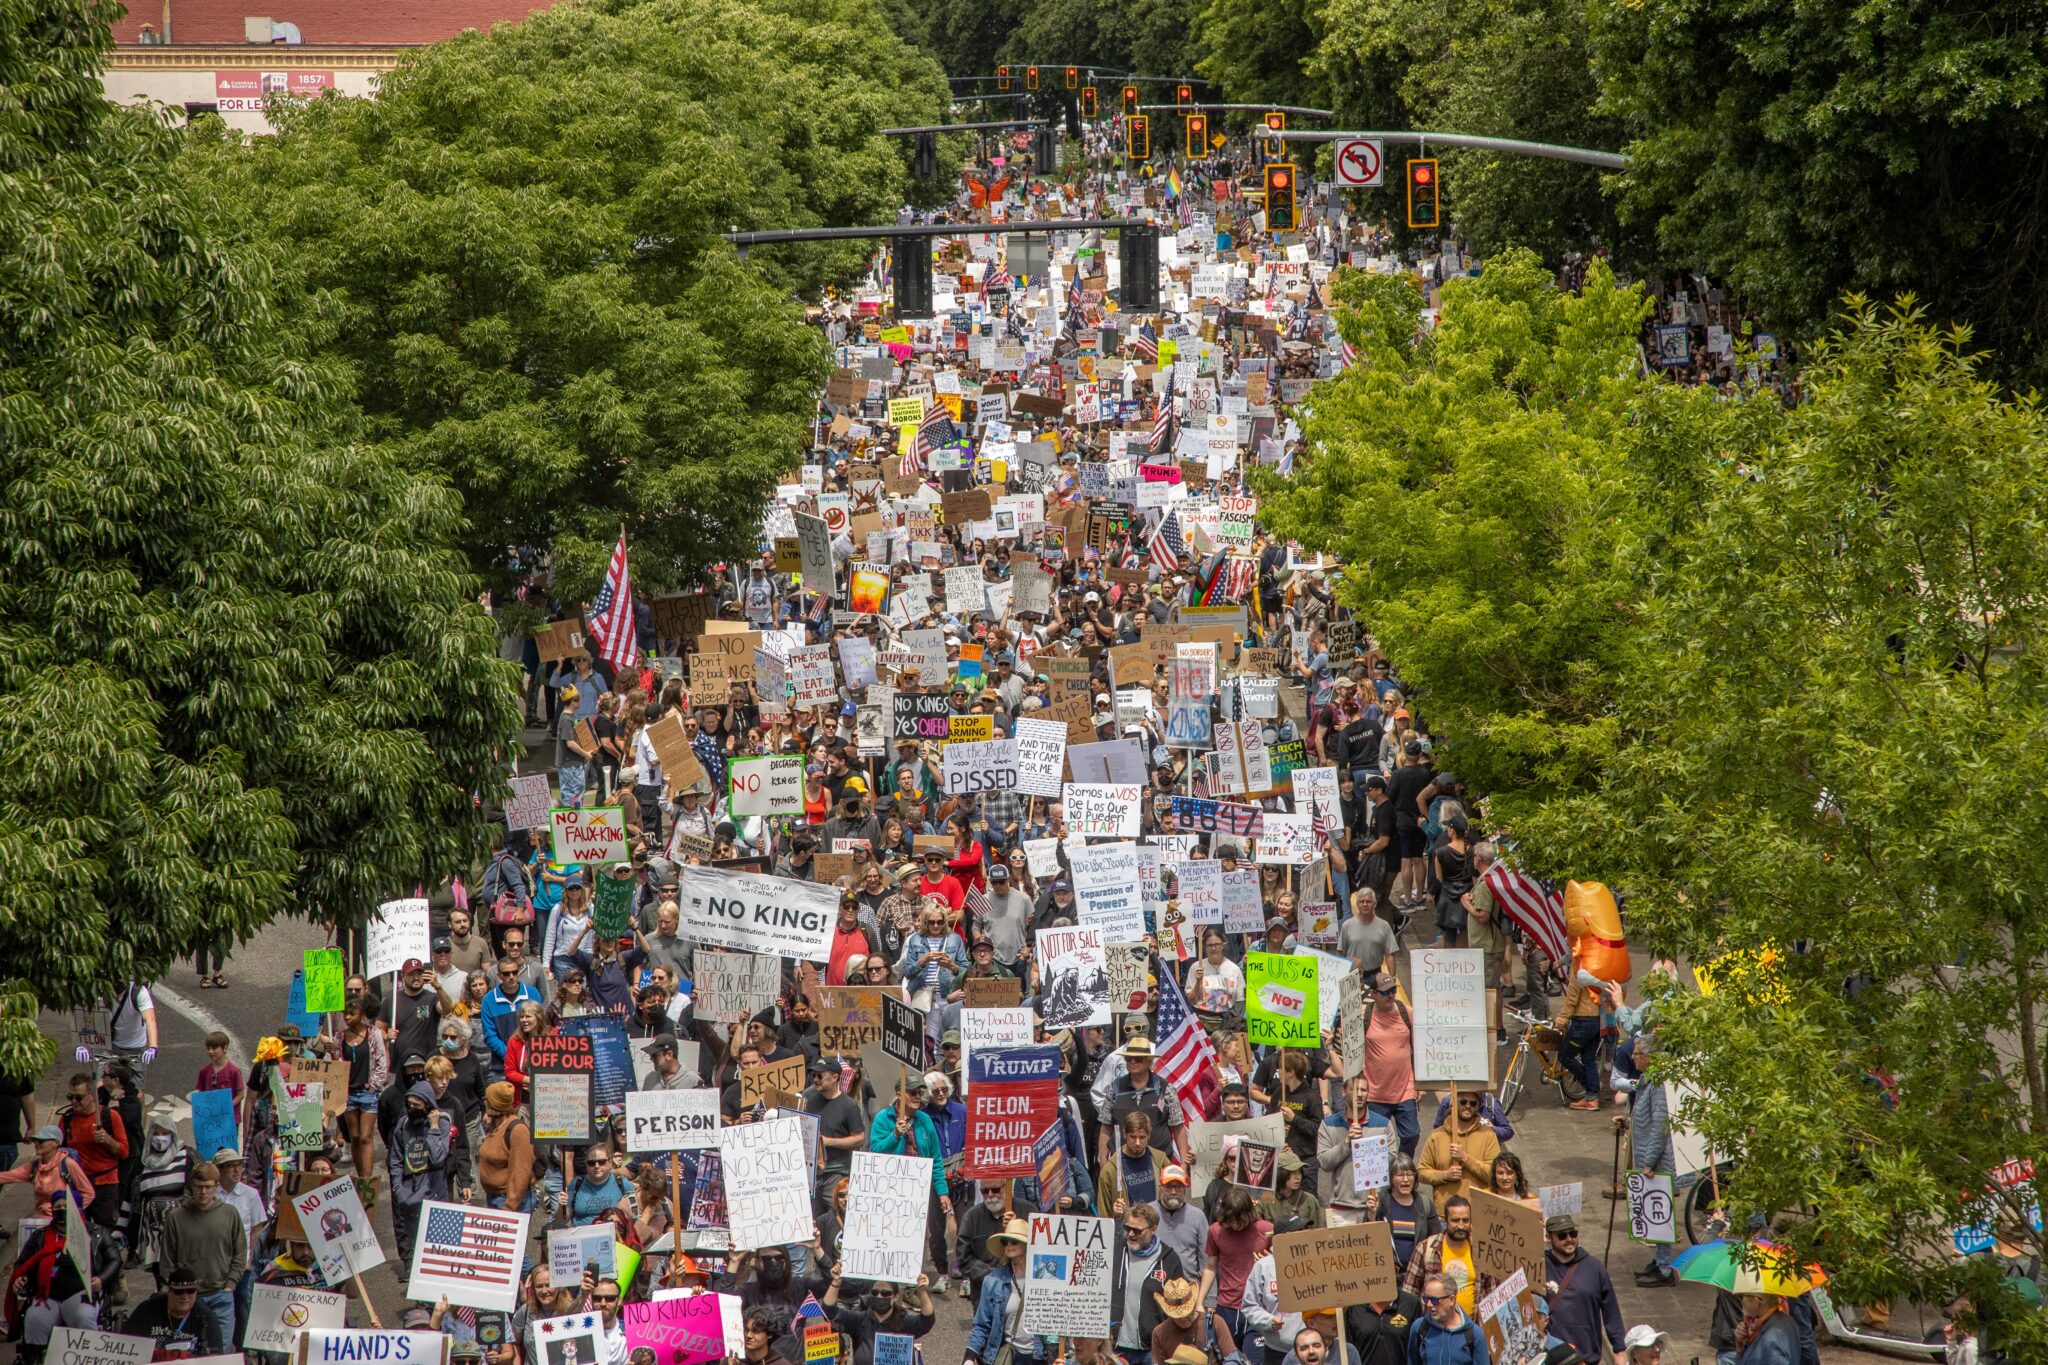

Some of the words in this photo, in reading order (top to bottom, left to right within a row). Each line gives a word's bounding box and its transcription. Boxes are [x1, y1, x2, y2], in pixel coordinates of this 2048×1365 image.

[299, 75, 325, 84] 1857!
[219, 99, 244, 110] FOR
[908, 386, 931, 395] LOVE
[981, 399, 1001, 407] WORST
[982, 413, 1004, 422] BETTER
[1209, 440, 1234, 448] RESIST
[1144, 467, 1177, 478] TRUMP
[1182, 464, 1206, 474] FIGHT
[1021, 501, 1035, 509] THE
[1223, 497, 1252, 511] STOP
[909, 511, 930, 519] FUCK
[1219, 511, 1254, 522] FASCISM
[798, 517, 826, 532] LOCK
[1222, 522, 1251, 534] SAVE
[909, 528, 931, 537] FUCK
[800, 533, 828, 549] THEM
[1217, 535, 1252, 547] DEMOCRACY
[809, 554, 826, 568] UP
[852, 562, 890, 574] TRAITOR
[655, 599, 708, 619] FIGHT
[719, 638, 744, 655] NO
[692, 656, 721, 668] Don't
[792, 654, 808, 663] THE
[810, 652, 828, 660] POOR
[879, 653, 925, 664] IMPEACH
[803, 662, 818, 670] WILL
[692, 672, 703, 682] go
[707, 668, 725, 679] back
[701, 681, 714, 691] to
[805, 678, 823, 689] EAT
[695, 690, 726, 705] sleep!
[953, 718, 979, 727] STOP
[1169, 708, 1208, 739] KINGS
[949, 728, 986, 737] ARMING
[968, 743, 982, 757] the
[984, 740, 1012, 758] People
[1020, 739, 1038, 749] AND
[1040, 741, 1061, 752] THEN
[1278, 741, 1303, 753] RICH
[1018, 749, 1038, 761] THEY
[1039, 752, 1061, 764] CAME
[1283, 751, 1303, 761] OUT
[770, 759, 802, 770] DICTATORS
[972, 759, 990, 769] ARE
[1019, 761, 1036, 772] FOR
[1039, 763, 1053, 774] ME
[951, 768, 1017, 793] PISSED
[1294, 772, 1306, 781] NO
[1309, 770, 1333, 780] KINGS
[732, 773, 761, 794] NO
[772, 776, 798, 786] KINGS
[1068, 785, 1103, 798] Somos
[1115, 787, 1138, 801] VOS
[1068, 798, 1083, 810] De
[1108, 802, 1128, 814] Que
[556, 812, 578, 825] NO
[1070, 811, 1082, 819] NO
[1086, 811, 1124, 823] Pueden
[565, 826, 624, 844] FAUX-KING
[1068, 820, 1119, 836] GRITAR!
[574, 848, 608, 860] WAY
[1258, 846, 1289, 856] PEOPLE
[1180, 866, 1220, 876] AMENDMENT
[1080, 887, 1124, 899] Separation
[1125, 885, 1134, 893] of
[1143, 881, 1157, 889] NO
[741, 888, 777, 898] WATCHING!
[1089, 898, 1128, 911] Powers
[708, 896, 746, 920] NO
[754, 904, 827, 933] KING!
[1102, 912, 1138, 925] president
[687, 919, 706, 927] Stand
[730, 925, 767, 937] constitution.
[771, 931, 787, 940] June
[1106, 923, 1124, 932] obey
[1126, 922, 1139, 930] the
[1158, 931, 1173, 939] NO
[1040, 931, 1062, 966] NOT
[1062, 931, 1076, 950] FOR
[1078, 929, 1100, 949] SALE
[1248, 962, 1264, 972] THE
[1268, 956, 1299, 981] US
[1302, 968, 1314, 979] IS
[1271, 992, 1302, 1011] NOT
[967, 1012, 986, 1028] Hey
[963, 1027, 994, 1040] Nobody
[1018, 1031, 1029, 1040] us
[1251, 1018, 1278, 1039] FOR
[1281, 1021, 1317, 1039] SALE
[531, 1036, 589, 1052] HANDS
[885, 1030, 909, 1059] FELON
[909, 1046, 920, 1066] 47
[531, 1052, 558, 1067] OFF
[562, 1054, 594, 1070] OUR
[974, 1053, 1053, 1078] TRUMP
[744, 1065, 801, 1100] RESIST
[287, 1084, 306, 1098] WE
[976, 1096, 1034, 1116] FELON.
[634, 1114, 715, 1135] PERSON
[975, 1120, 1035, 1140] FRAUD.
[722, 1119, 801, 1150] AMERICA
[724, 1157, 750, 1178] NO
[756, 1150, 803, 1175] KING
[855, 1155, 880, 1173] THE
[885, 1156, 926, 1177] ONLY
[851, 1175, 928, 1198] MINORITY
[300, 1195, 321, 1216] NO
[323, 1180, 354, 1201] KINGS
[729, 1195, 766, 1221] RED
[769, 1189, 806, 1215] HAT
[847, 1194, 926, 1218] DESTROYING
[470, 1216, 508, 1234] Kings
[846, 1215, 924, 1238] AMERICA
[473, 1232, 498, 1247] Will
[732, 1224, 768, 1249] RED
[771, 1216, 809, 1243] COAT
[1031, 1217, 1107, 1249] MAFA
[1488, 1223, 1506, 1240] NO
[1510, 1232, 1525, 1248] TO
[554, 1243, 569, 1252] How
[874, 1240, 888, 1248] IS
[431, 1244, 472, 1259] Never
[475, 1249, 506, 1263] Rule
[555, 1251, 567, 1259] Win
[1075, 1250, 1104, 1260] MAKE
[555, 1259, 581, 1267] Election
[843, 1250, 922, 1279] BILLIONAIRES
[1073, 1259, 1109, 1270] AMERICA
[1284, 1260, 1316, 1280] OUR
[1322, 1253, 1371, 1274] PARADE
[1376, 1253, 1386, 1267] is
[1478, 1241, 1543, 1283] FASCISM!
[450, 1263, 480, 1277] U.S.
[555, 1268, 567, 1276] 101
[1071, 1268, 1097, 1276] FREE
[1069, 1276, 1101, 1287] AGAIN
[1031, 1288, 1050, 1296] FREE
[1294, 1281, 1328, 1300] better
[1335, 1279, 1358, 1293] than
[258, 1289, 282, 1299] TRUE
[287, 1291, 338, 1306] DEMOCRACY
[628, 1303, 651, 1325] NO
[657, 1294, 713, 1322] KINGS
[806, 1327, 829, 1336] SUPER
[636, 1324, 671, 1346] JUST
[672, 1325, 724, 1354] QUEENS
[807, 1336, 839, 1347] CALLOUS
[324, 1335, 410, 1361] HAND'S
[807, 1347, 837, 1358] FASCIST
